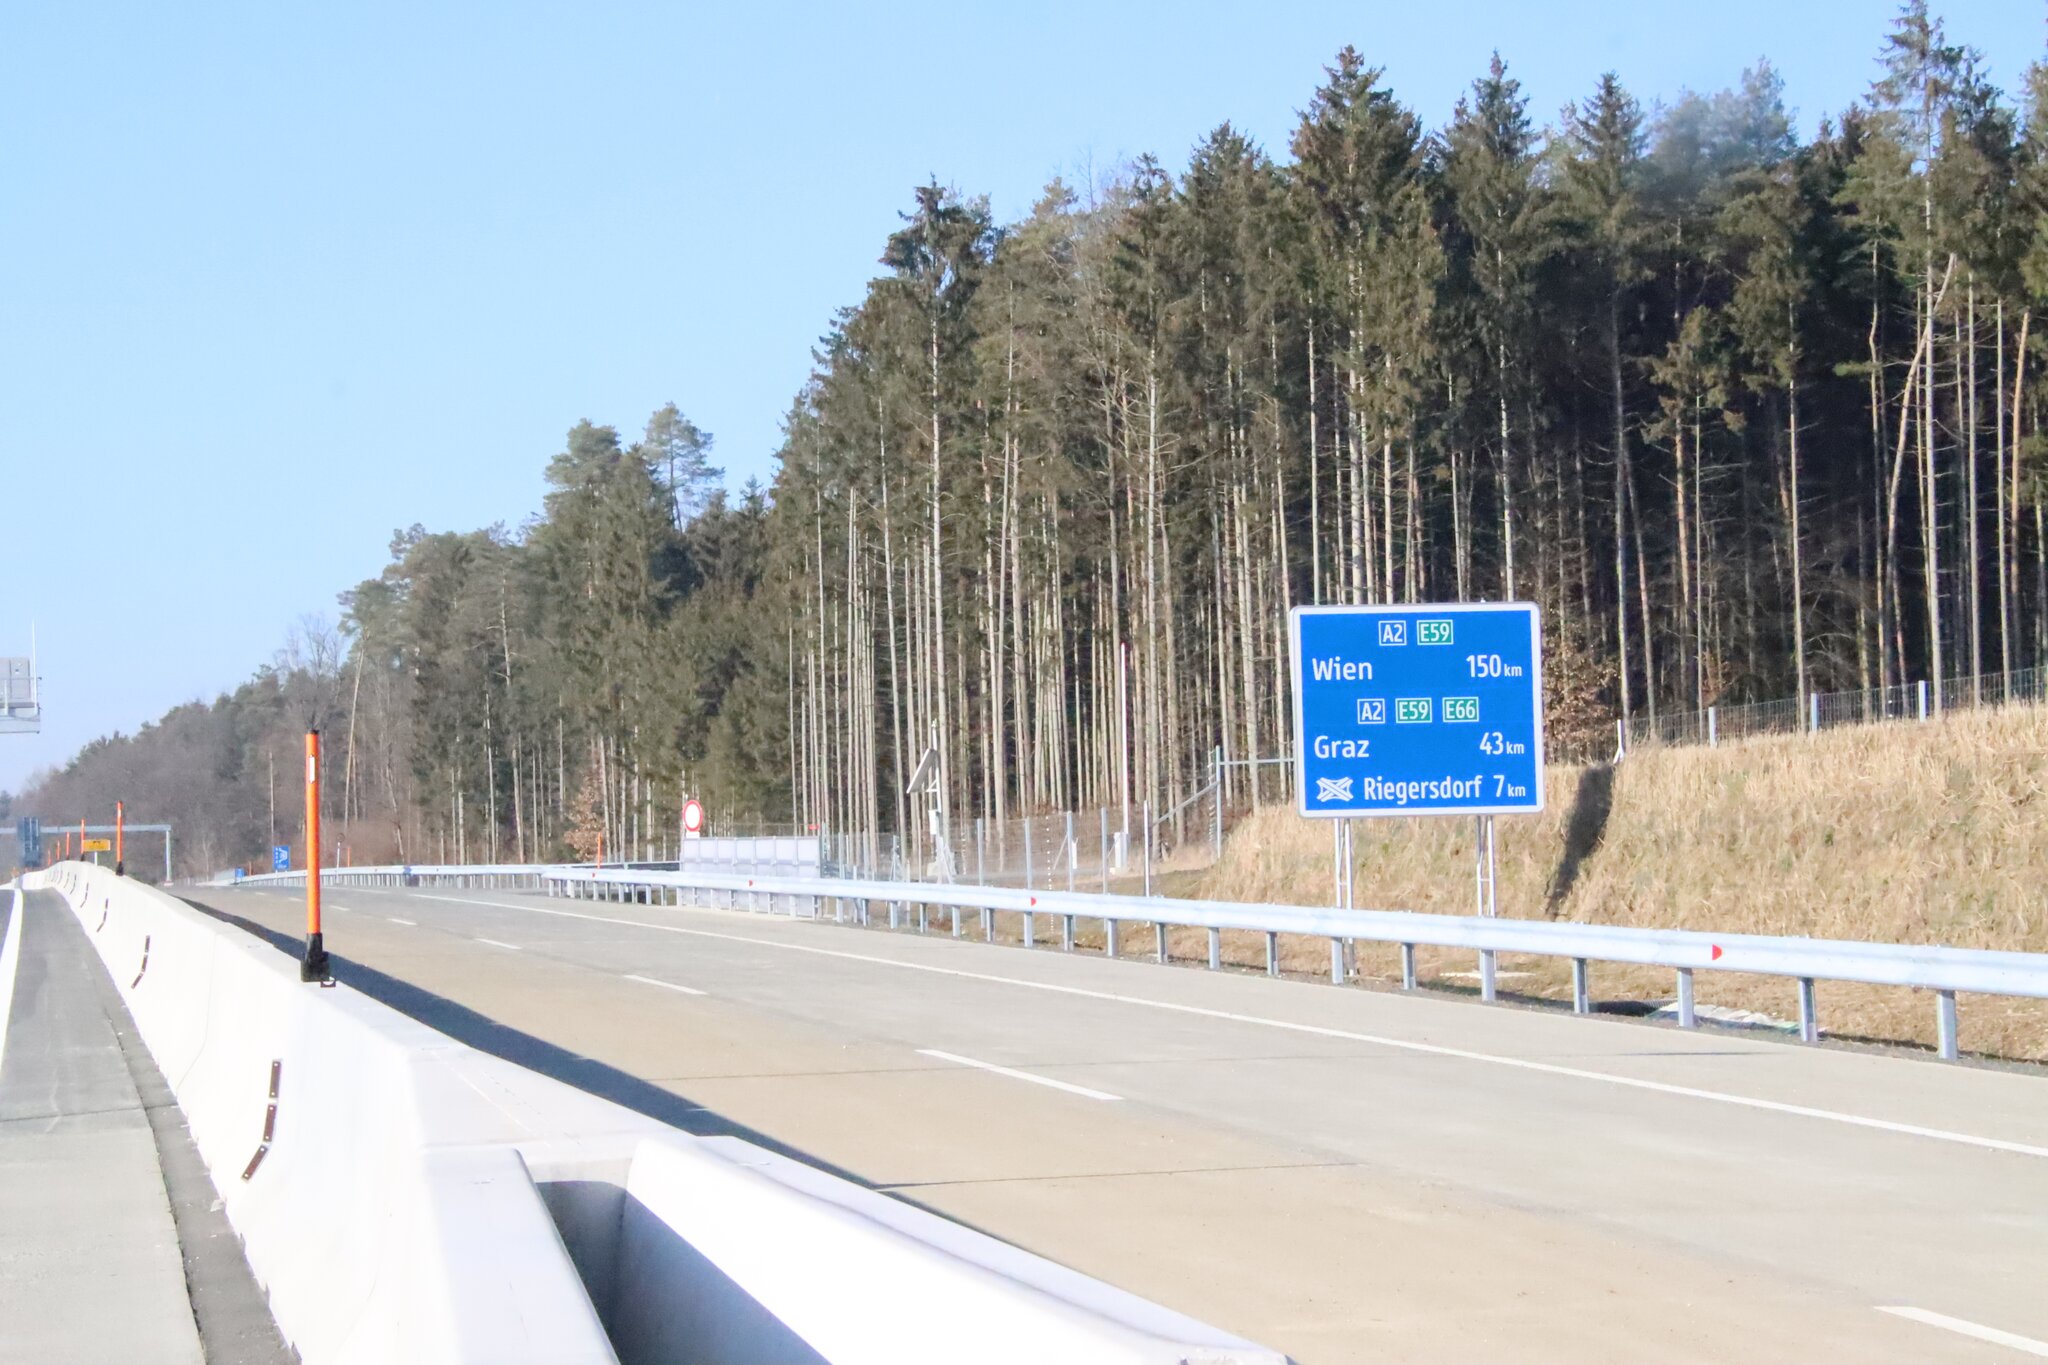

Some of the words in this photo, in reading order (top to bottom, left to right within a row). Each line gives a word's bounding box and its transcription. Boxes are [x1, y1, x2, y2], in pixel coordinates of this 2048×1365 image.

[1382, 623, 1403, 643] A2
[1420, 622, 1450, 642] E59
[1312, 656, 1373, 681] Wien
[1466, 654, 1502, 678] 150
[1503, 663, 1522, 677] km
[1361, 701, 1382, 721] A2
[1398, 701, 1429, 720] E59
[1445, 700, 1476, 719] E66
[1314, 735, 1370, 759] Graz
[1479, 731, 1504, 755] 43
[1506, 741, 1525, 754] km
[1364, 774, 1483, 805] Riegersdorf
[1493, 774, 1505, 798] 7
[1507, 783, 1526, 797] km
